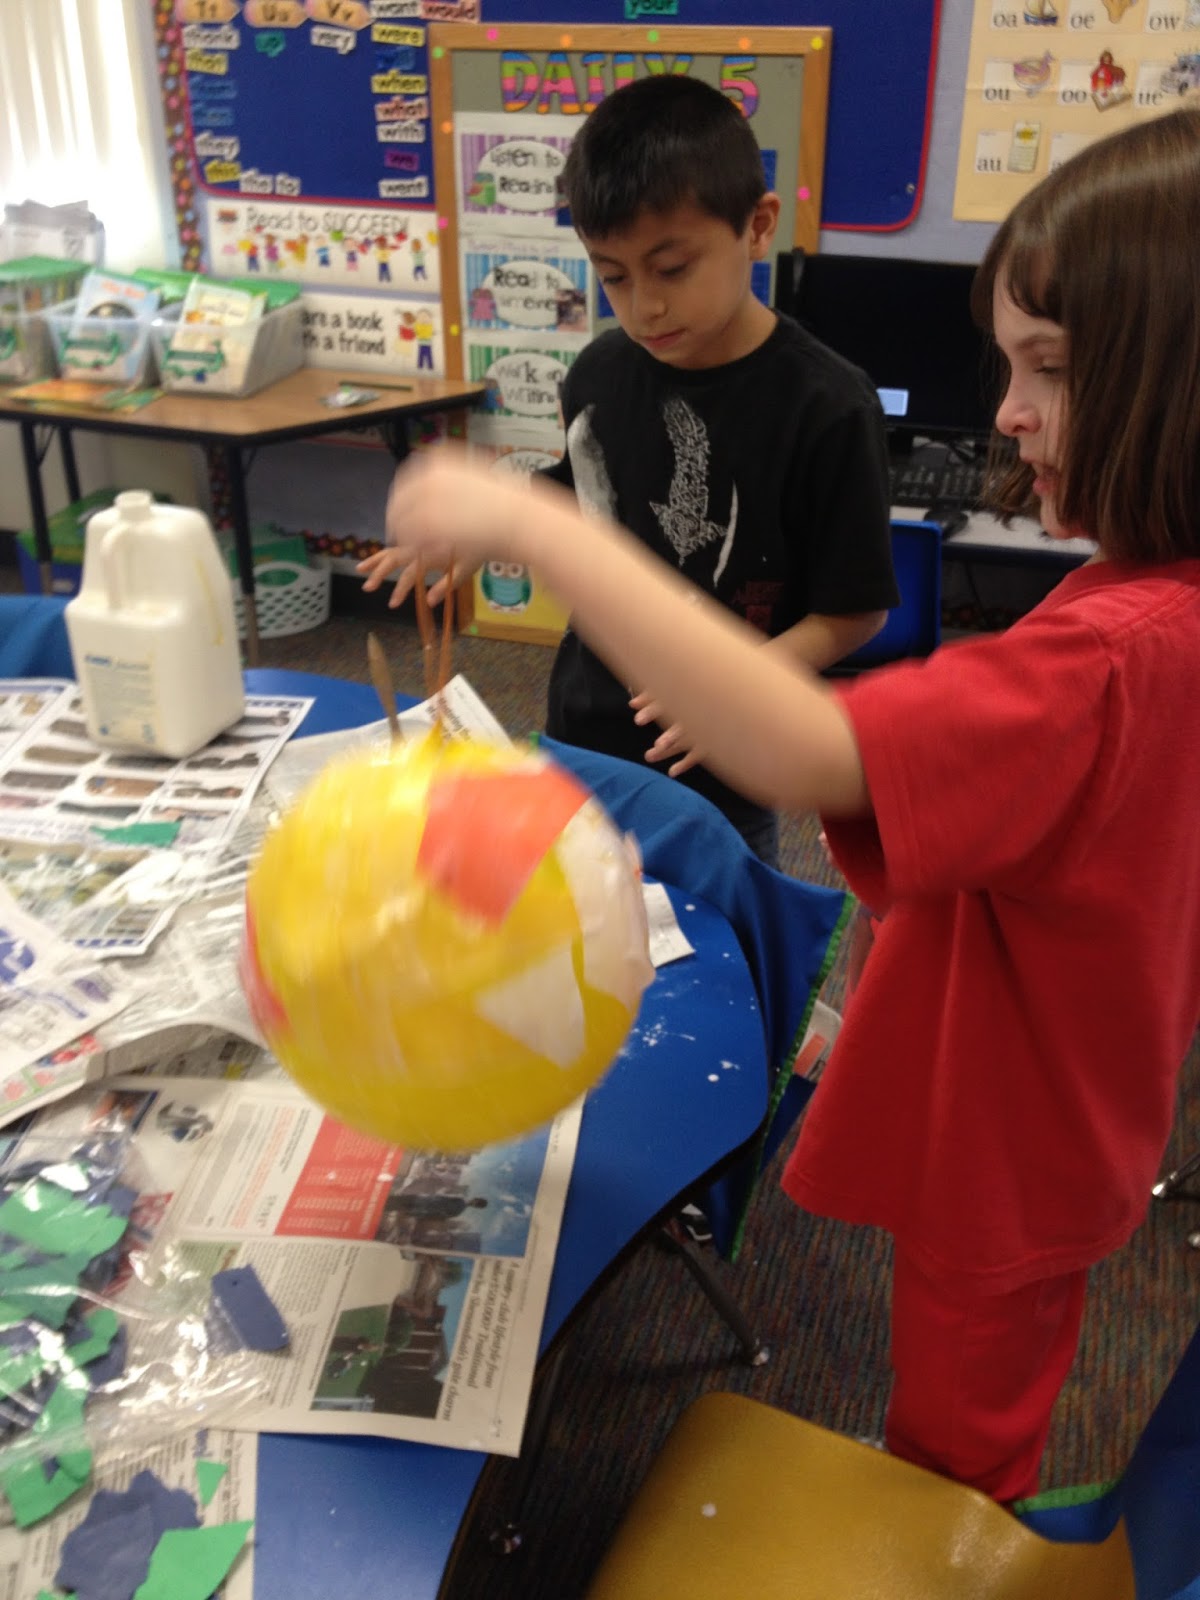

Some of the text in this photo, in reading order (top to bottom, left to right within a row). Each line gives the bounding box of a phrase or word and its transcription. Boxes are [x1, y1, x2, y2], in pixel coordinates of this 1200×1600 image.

[993, 12, 1018, 28] oa
[1070, 14, 1095, 29] oe
[1149, 15, 1180, 30] ow
[720, 55, 760, 119] 5
[985, 88, 1010, 101] ou
[1061, 89, 1087, 103] oo
[545, 150, 562, 168] to
[977, 158, 1001, 172] au
[247, 206, 292, 230] Read
[298, 208, 319, 232] to
[493, 266, 561, 290] Read to
[331, 312, 342, 329] a
[345, 308, 384, 332] book
[323, 334, 335, 351] a
[338, 331, 387, 356] friend
